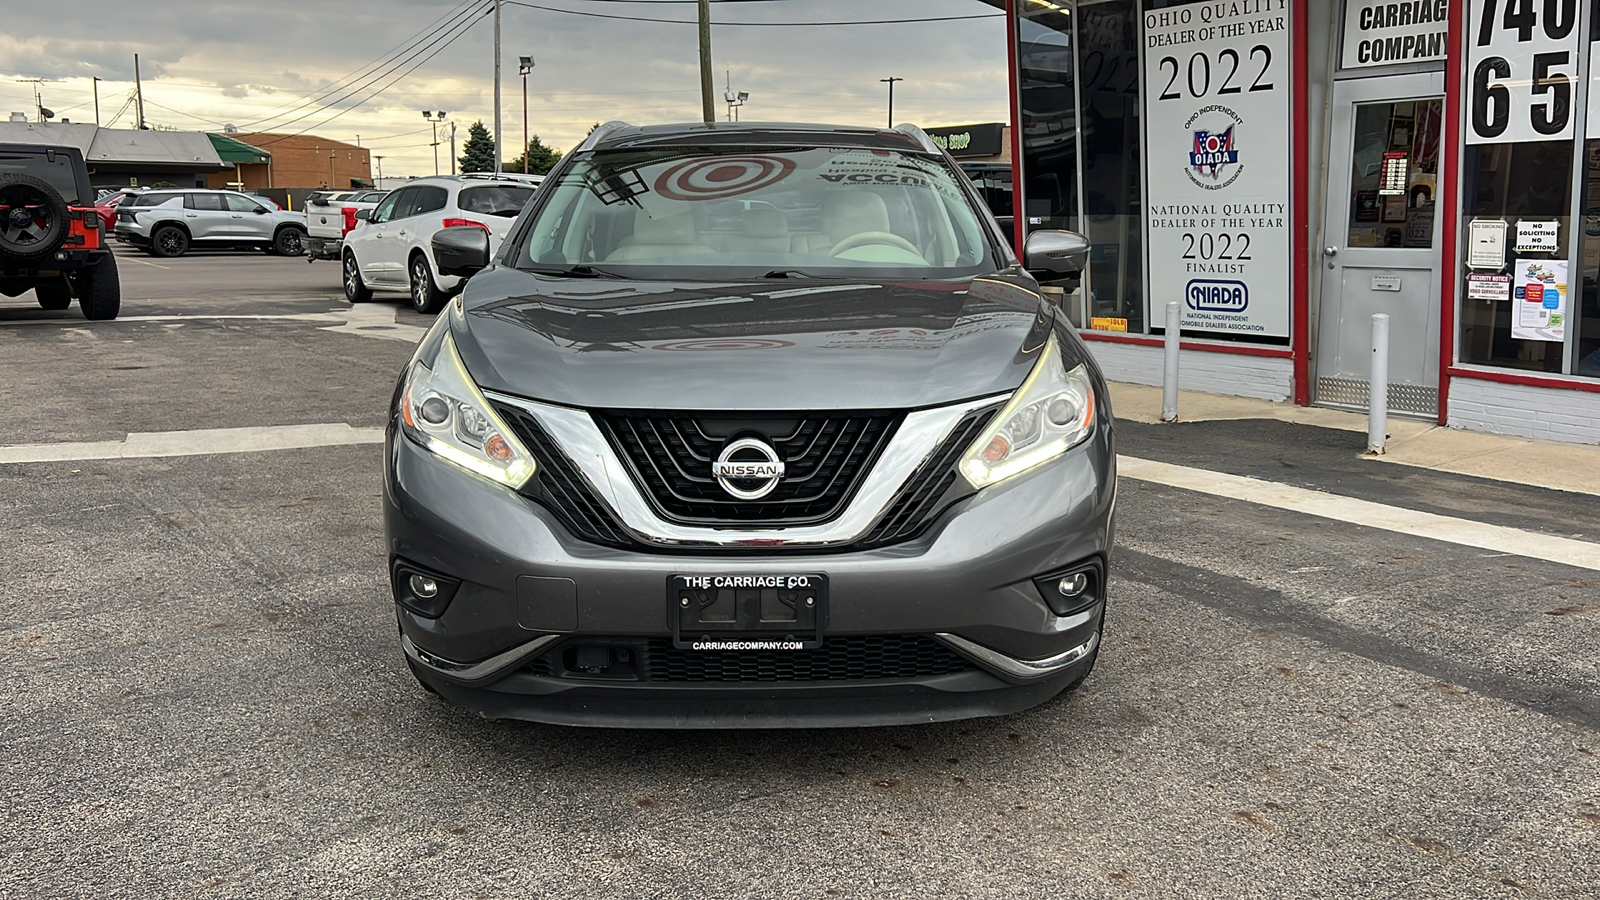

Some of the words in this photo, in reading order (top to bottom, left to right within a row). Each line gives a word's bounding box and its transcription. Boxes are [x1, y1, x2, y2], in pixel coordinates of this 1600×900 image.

[1146, 9, 1192, 29] OHIO
[1201, 0, 1285, 23] QUALITY
[1148, 29, 1196, 48] DEALER
[1198, 26, 1216, 41] OF
[1218, 22, 1246, 38] THE
[1248, 16, 1285, 34] YEAR
[1158, 44, 1274, 101] 2022
[1184, 112, 1199, 129] OHIO
[1199, 104, 1244, 125] INDEPENDENT
[949, 131, 971, 149] SHOP
[1195, 151, 1230, 165] OIADA
[1204, 183, 1223, 191] DEALERS
[1151, 204, 1217, 215] NATIONAL
[1223, 203, 1285, 216] QUALITY
[1152, 218, 1196, 228] DEALER
[1201, 218, 1216, 228] OF
[1221, 218, 1245, 228] THE
[1250, 218, 1283, 228] YEAR
[1181, 232, 1252, 261] 2022
[1186, 263, 1245, 273] FINALIST
[1190, 286, 1242, 307] NIADA
[1186, 312, 1212, 320] NATIONAL
[1212, 314, 1249, 322] INDEPENDENT
[1180, 320, 1204, 328] OMOBILE
[1205, 321, 1227, 329] DEALERS
[1228, 323, 1265, 332] ASSOCIATION
[720, 465, 777, 475] NISSAN
[683, 576, 711, 588] THE
[714, 576, 785, 588] CARRIAGE
[787, 576, 812, 588] CO.
[692, 641, 803, 650] CARRIAGECOMPANY.COM
